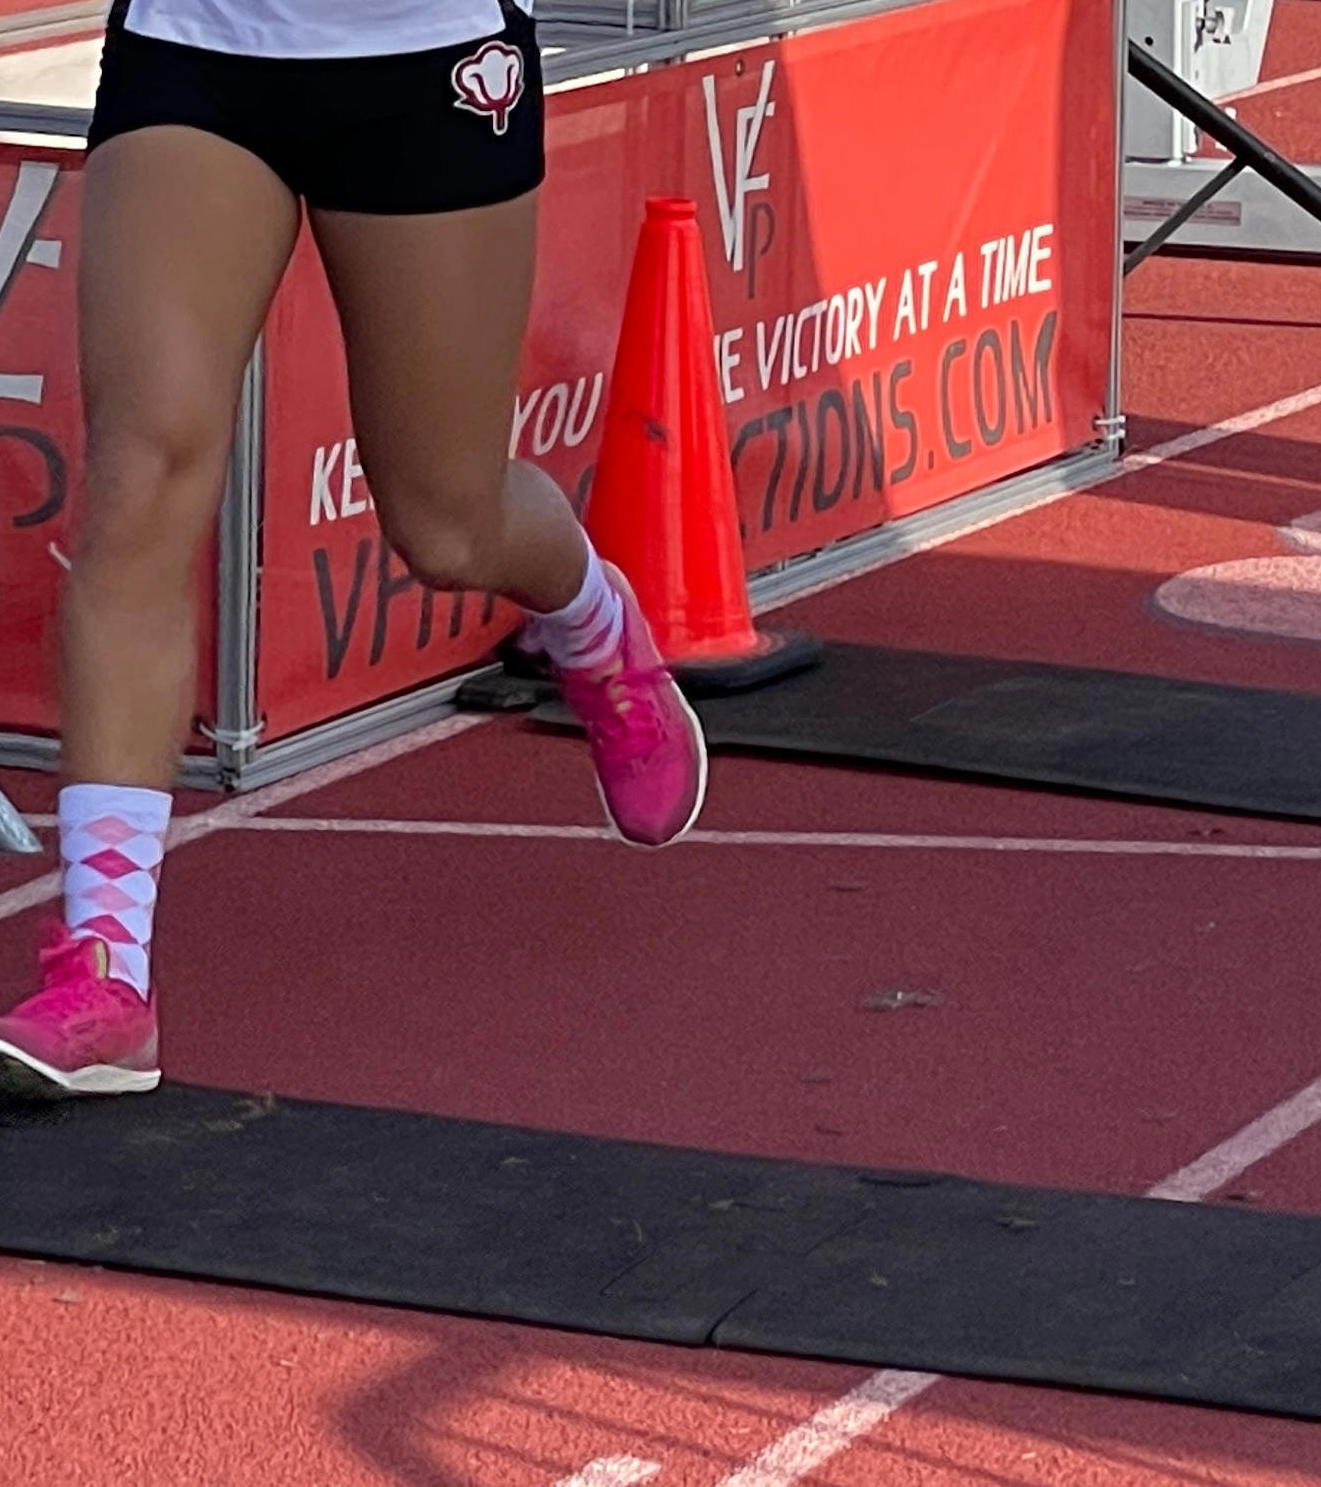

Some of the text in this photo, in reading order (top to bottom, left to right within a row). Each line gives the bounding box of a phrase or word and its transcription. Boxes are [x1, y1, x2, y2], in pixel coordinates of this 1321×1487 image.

[756, 277, 886, 390] VICTORY
[893, 260, 938, 341] AT
[943, 251, 967, 323] A
[980, 223, 1054, 309] TIME
